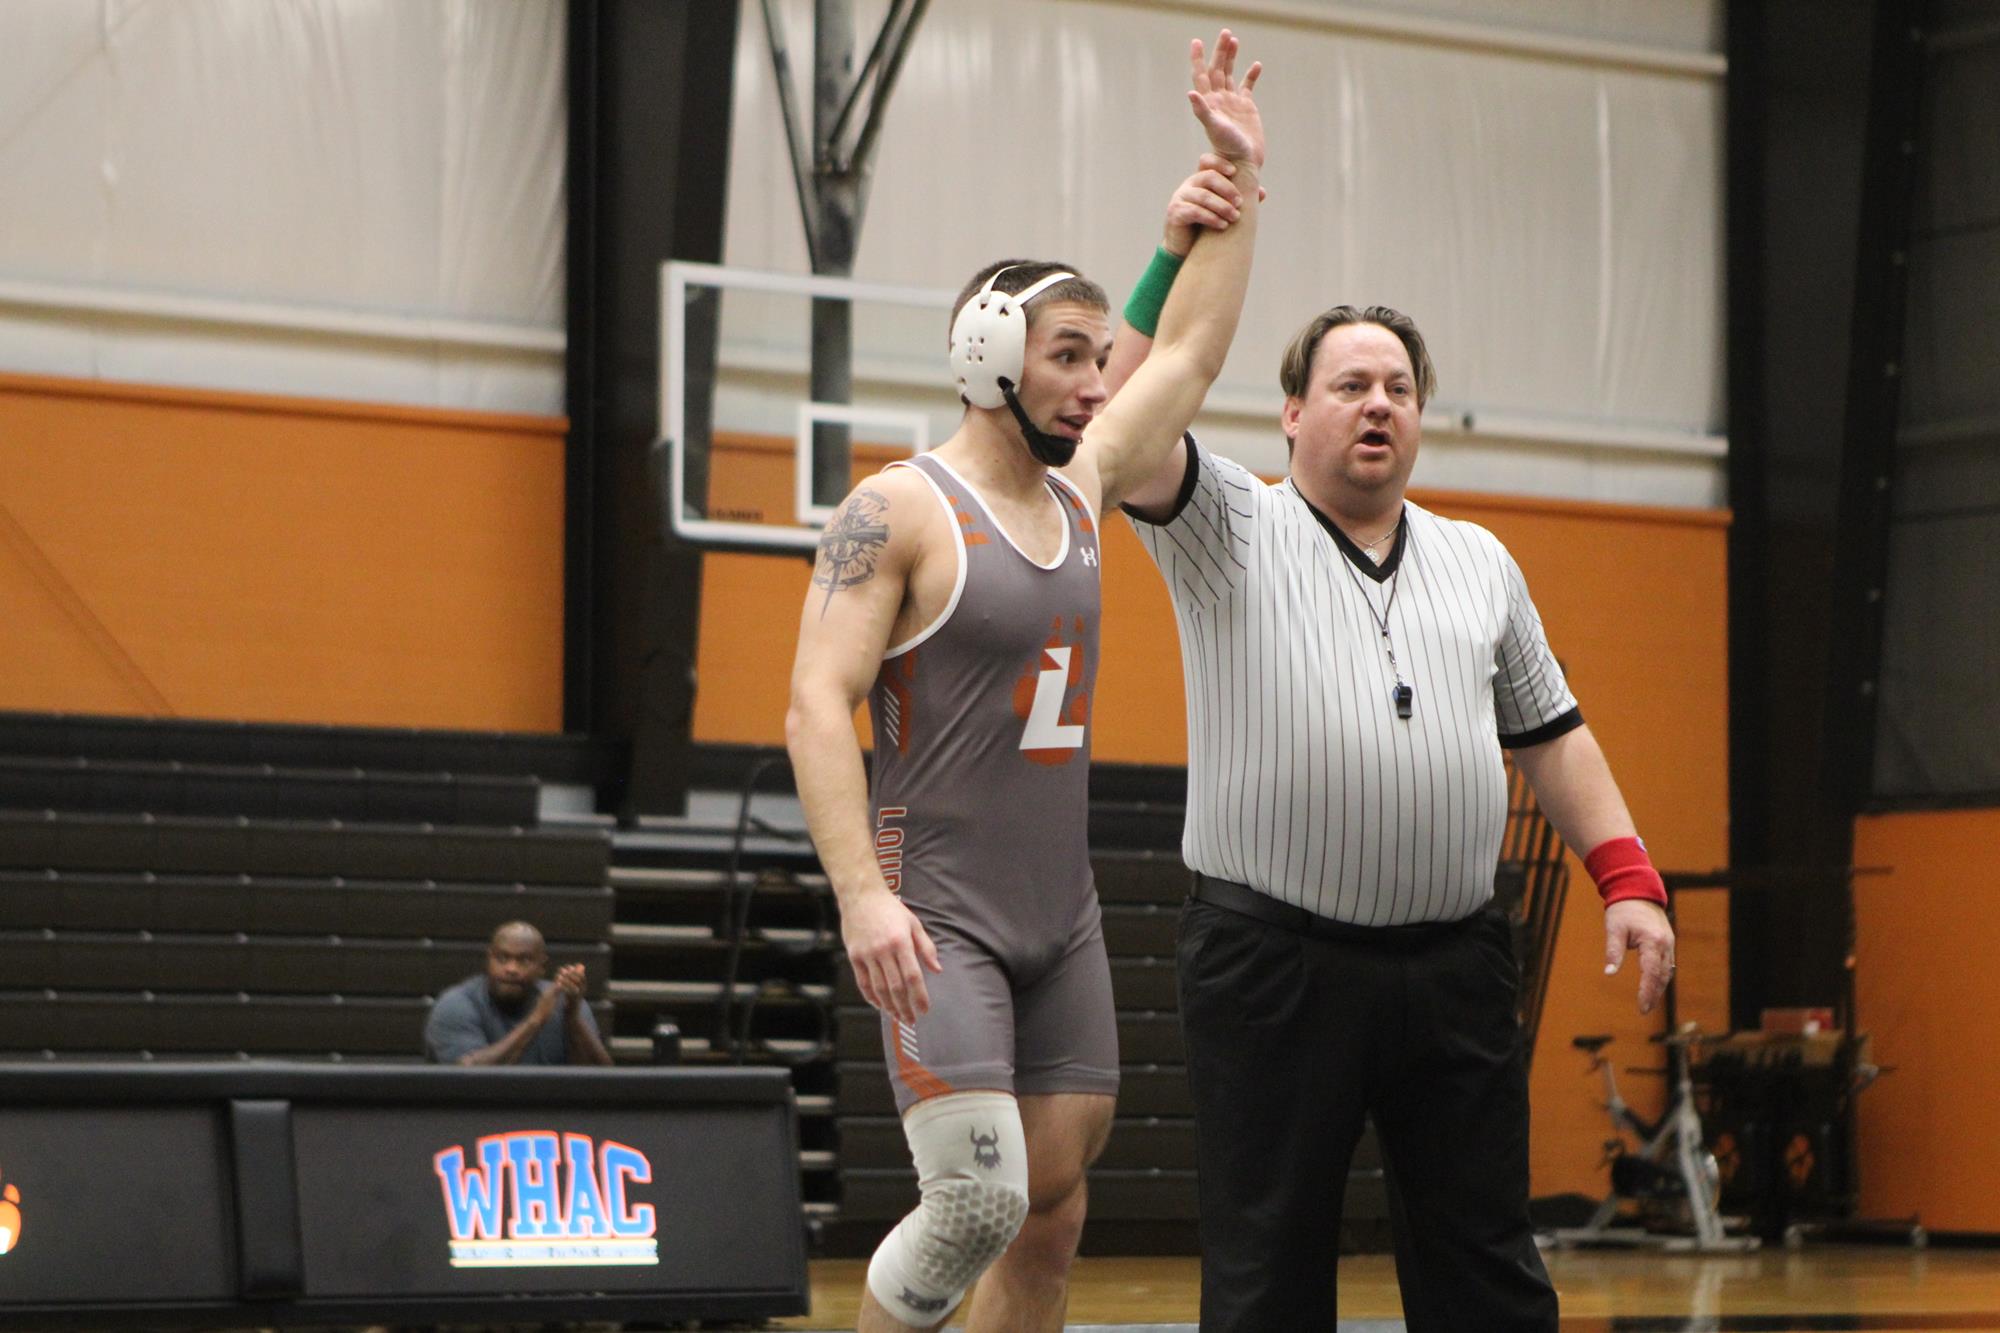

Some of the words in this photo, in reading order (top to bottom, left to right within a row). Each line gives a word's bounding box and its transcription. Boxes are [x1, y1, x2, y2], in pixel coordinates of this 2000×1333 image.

[1019, 647, 1085, 750] L
[875, 806, 907, 901] LOUR
[434, 1130, 657, 1240] WHAC
